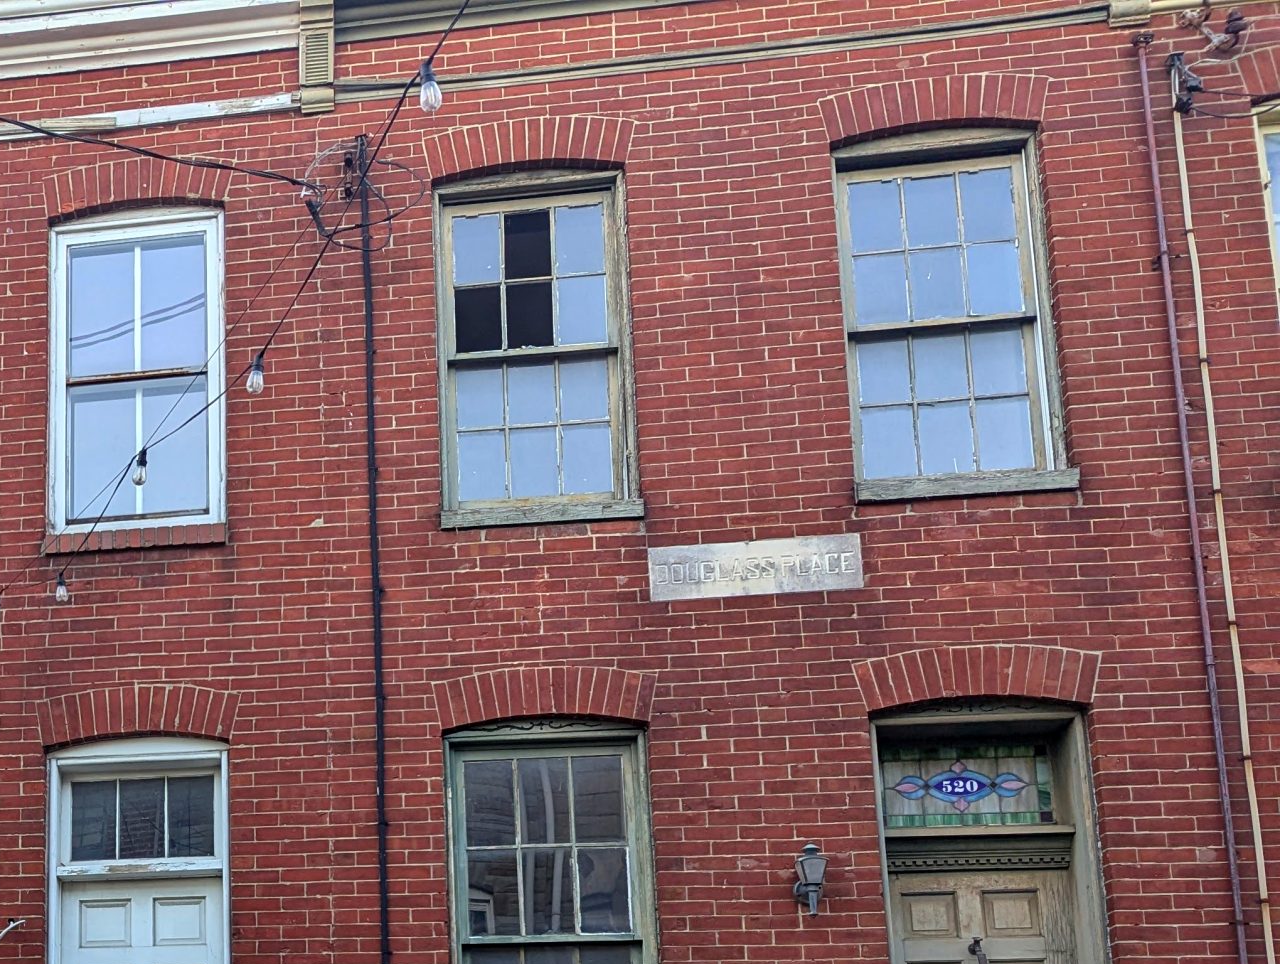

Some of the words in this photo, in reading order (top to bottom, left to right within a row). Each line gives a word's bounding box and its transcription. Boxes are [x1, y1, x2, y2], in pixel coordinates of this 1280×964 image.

[655, 556, 774, 585] DOUGLASS
[780, 551, 856, 577] PLACE
[942, 779, 979, 793] 520
